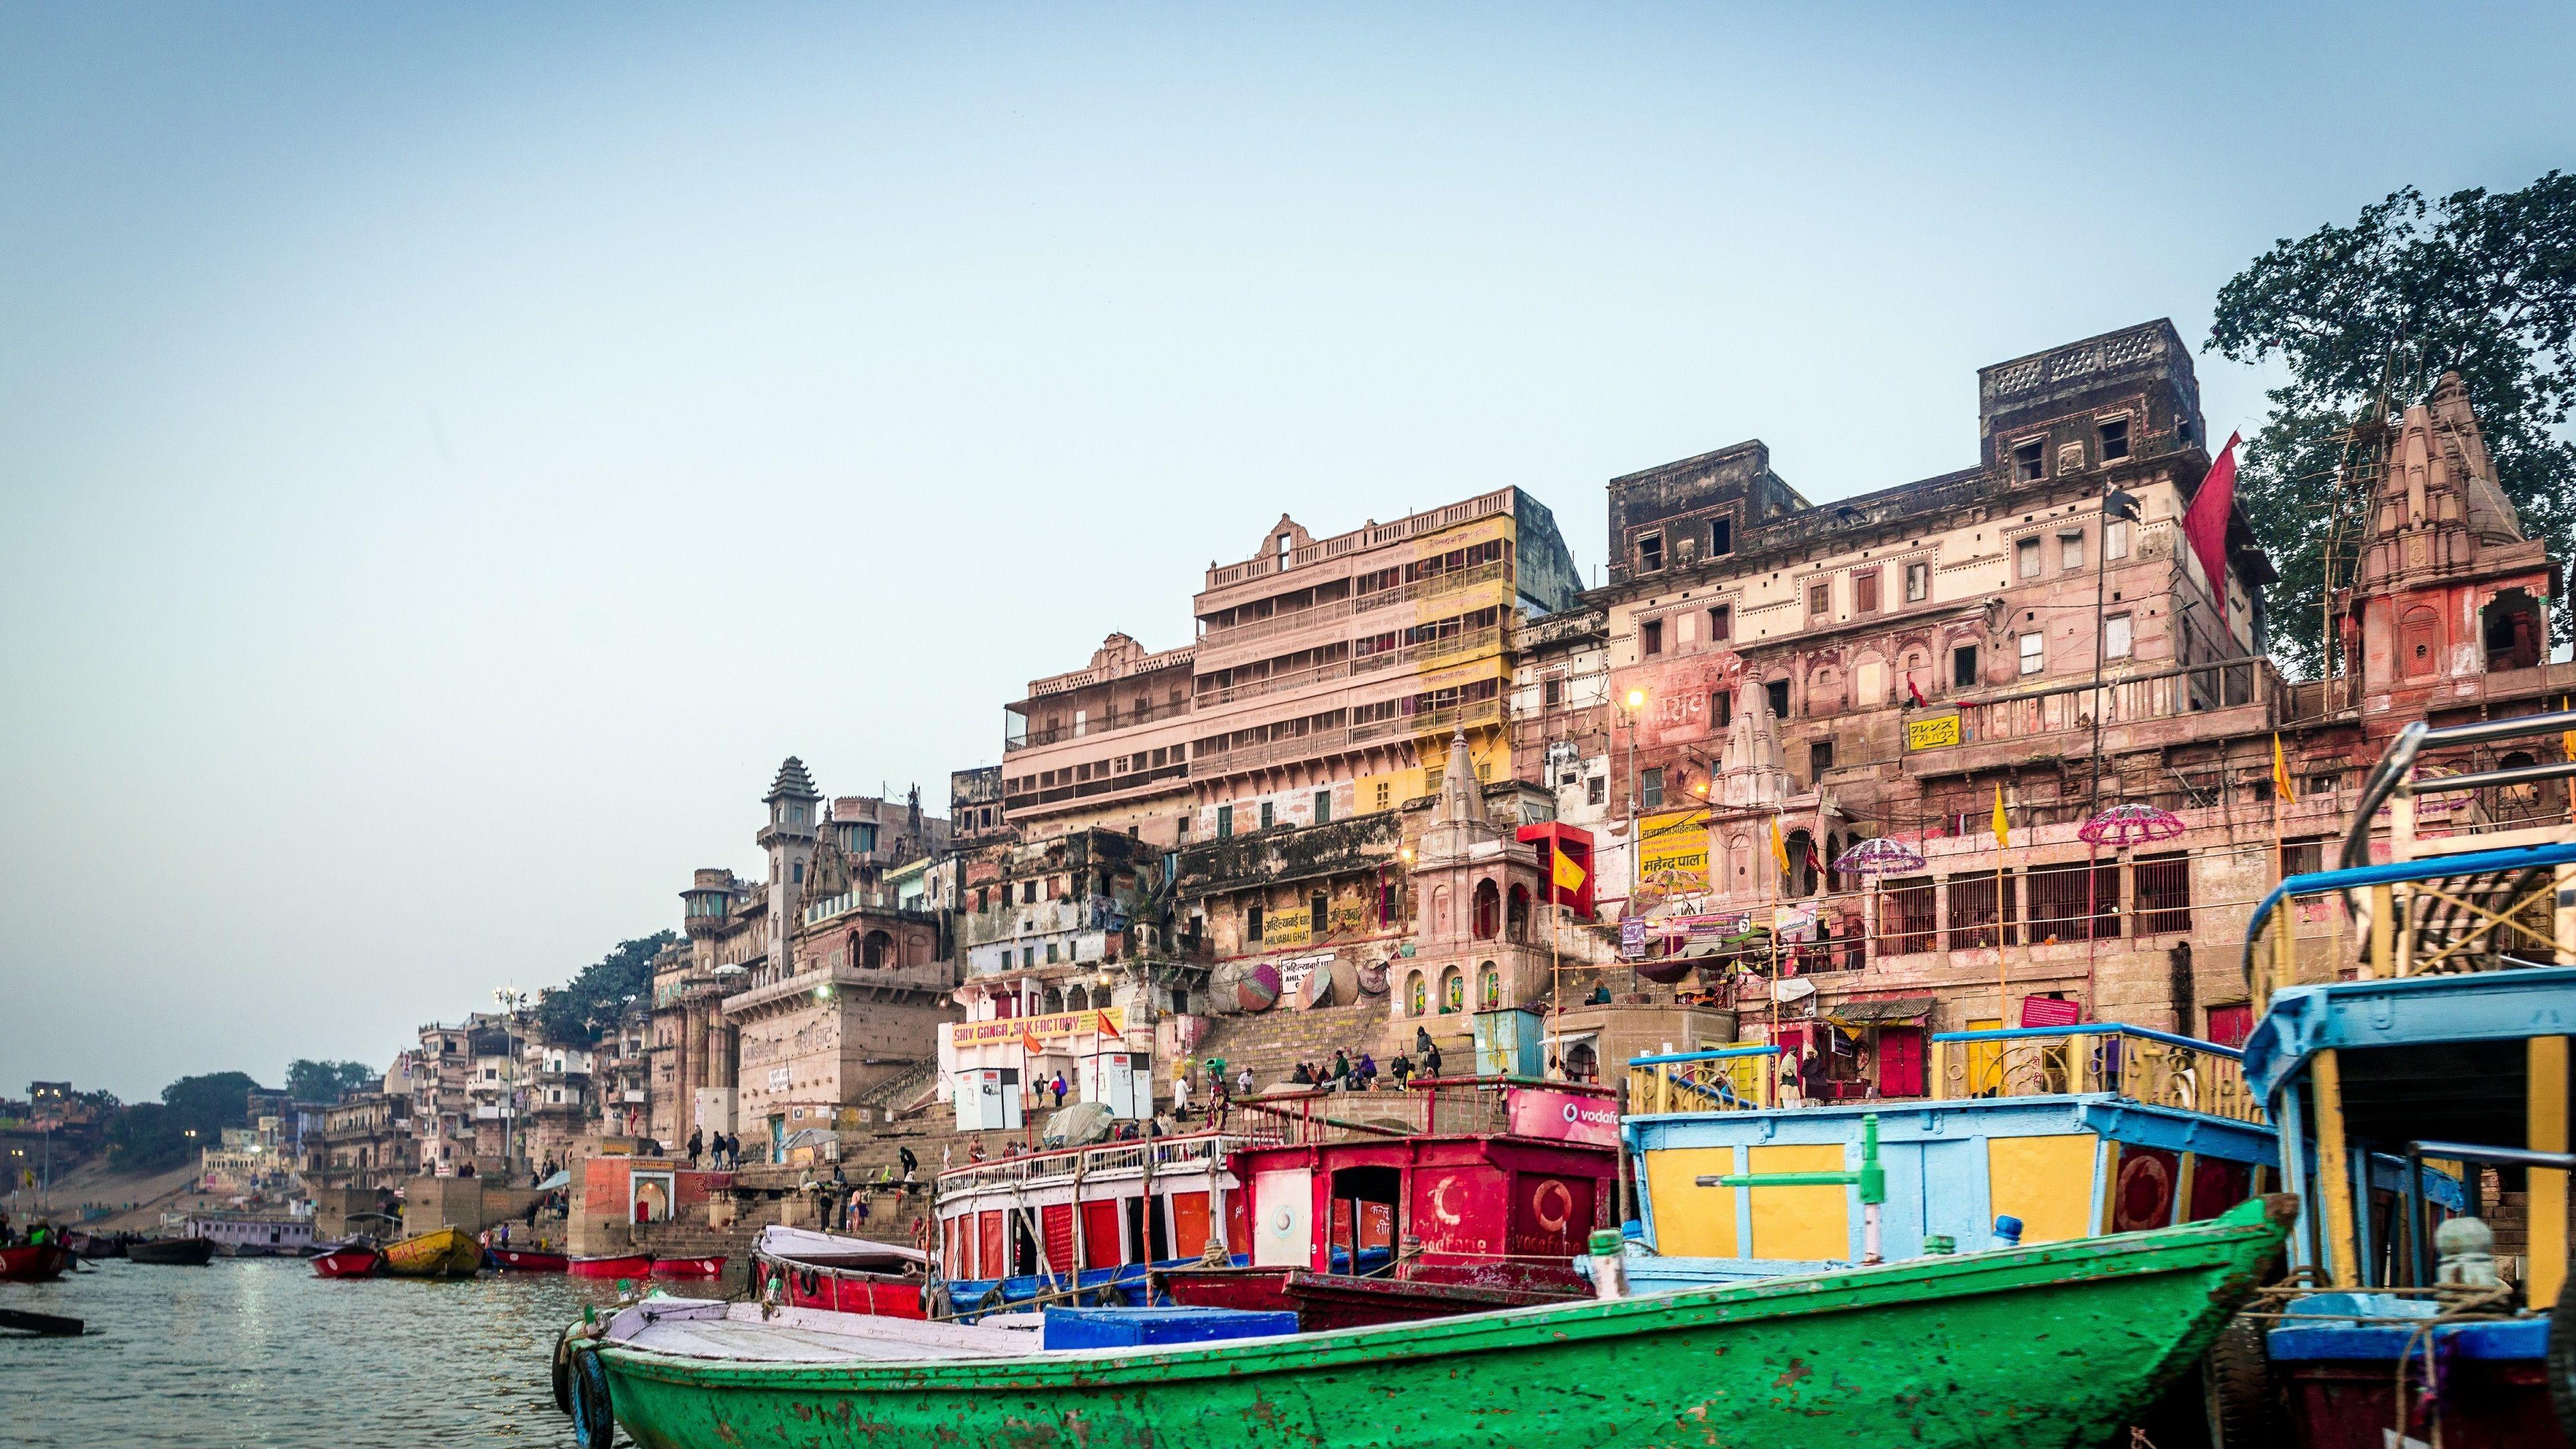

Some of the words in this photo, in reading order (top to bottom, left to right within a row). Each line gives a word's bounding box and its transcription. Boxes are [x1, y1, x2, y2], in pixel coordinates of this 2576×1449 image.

[1677, 855, 1699, 867] पाल
[1264, 913, 1299, 932] अहिल्याबाई
[1299, 915, 1310, 926] घाट
[1265, 934, 1292, 946] AHILYABAI
[1293, 930, 1309, 942] GHAT
[955, 1028, 975, 1042] SHIV
[977, 1024, 1008, 1039] GANGA
[1034, 1016, 1079, 1032] FACTORY
